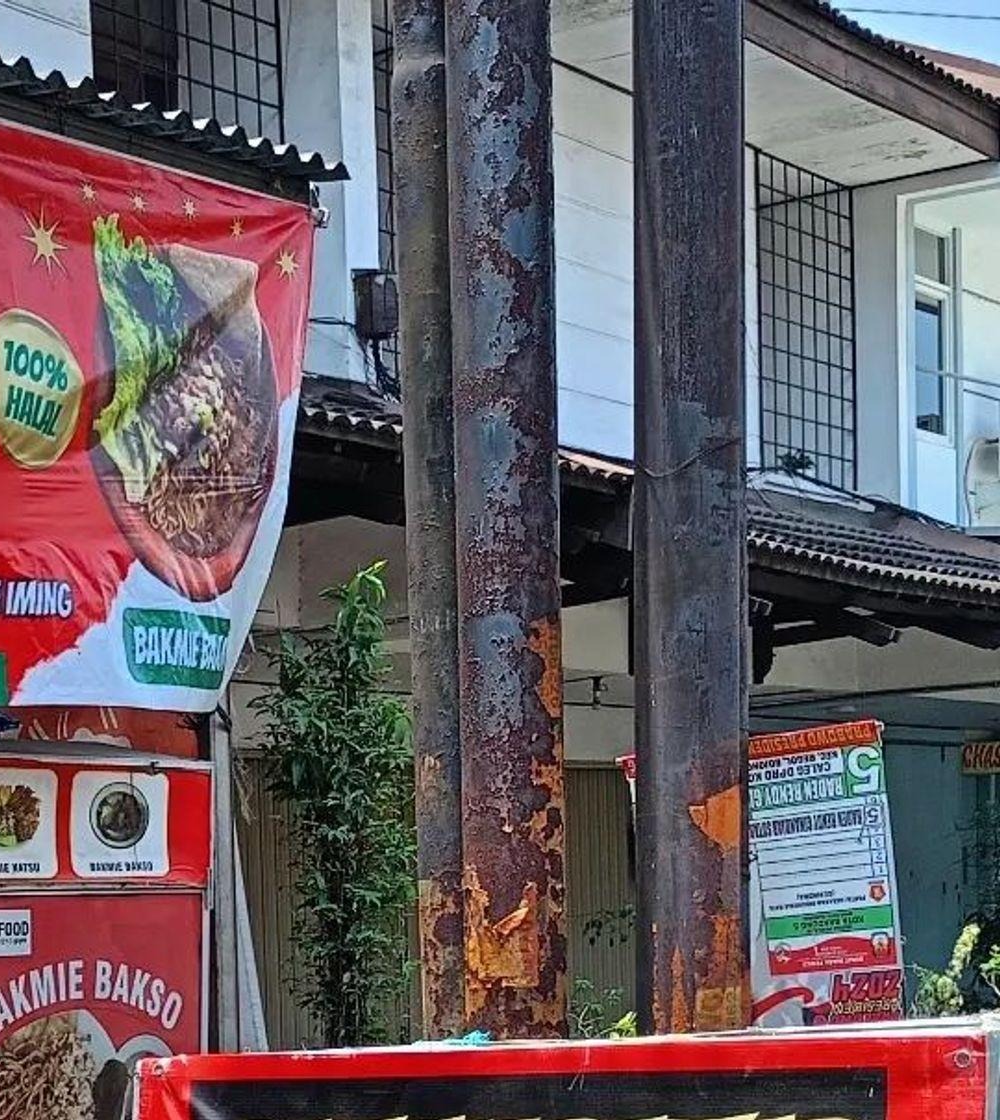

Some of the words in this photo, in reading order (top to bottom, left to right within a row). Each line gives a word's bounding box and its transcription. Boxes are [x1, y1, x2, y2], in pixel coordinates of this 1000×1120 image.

[2, 339, 69, 393] 100%
[4, 384, 63, 438] HALAL
[5, 581, 73, 618] IMING
[133, 625, 201, 668] BAKMIE
[803, 774, 843, 799] RADEN
[848, 746, 880, 795] 5
[866, 807, 879, 824] 5
[95, 959, 183, 1029] BAKSO
[833, 969, 901, 1000] 2024
